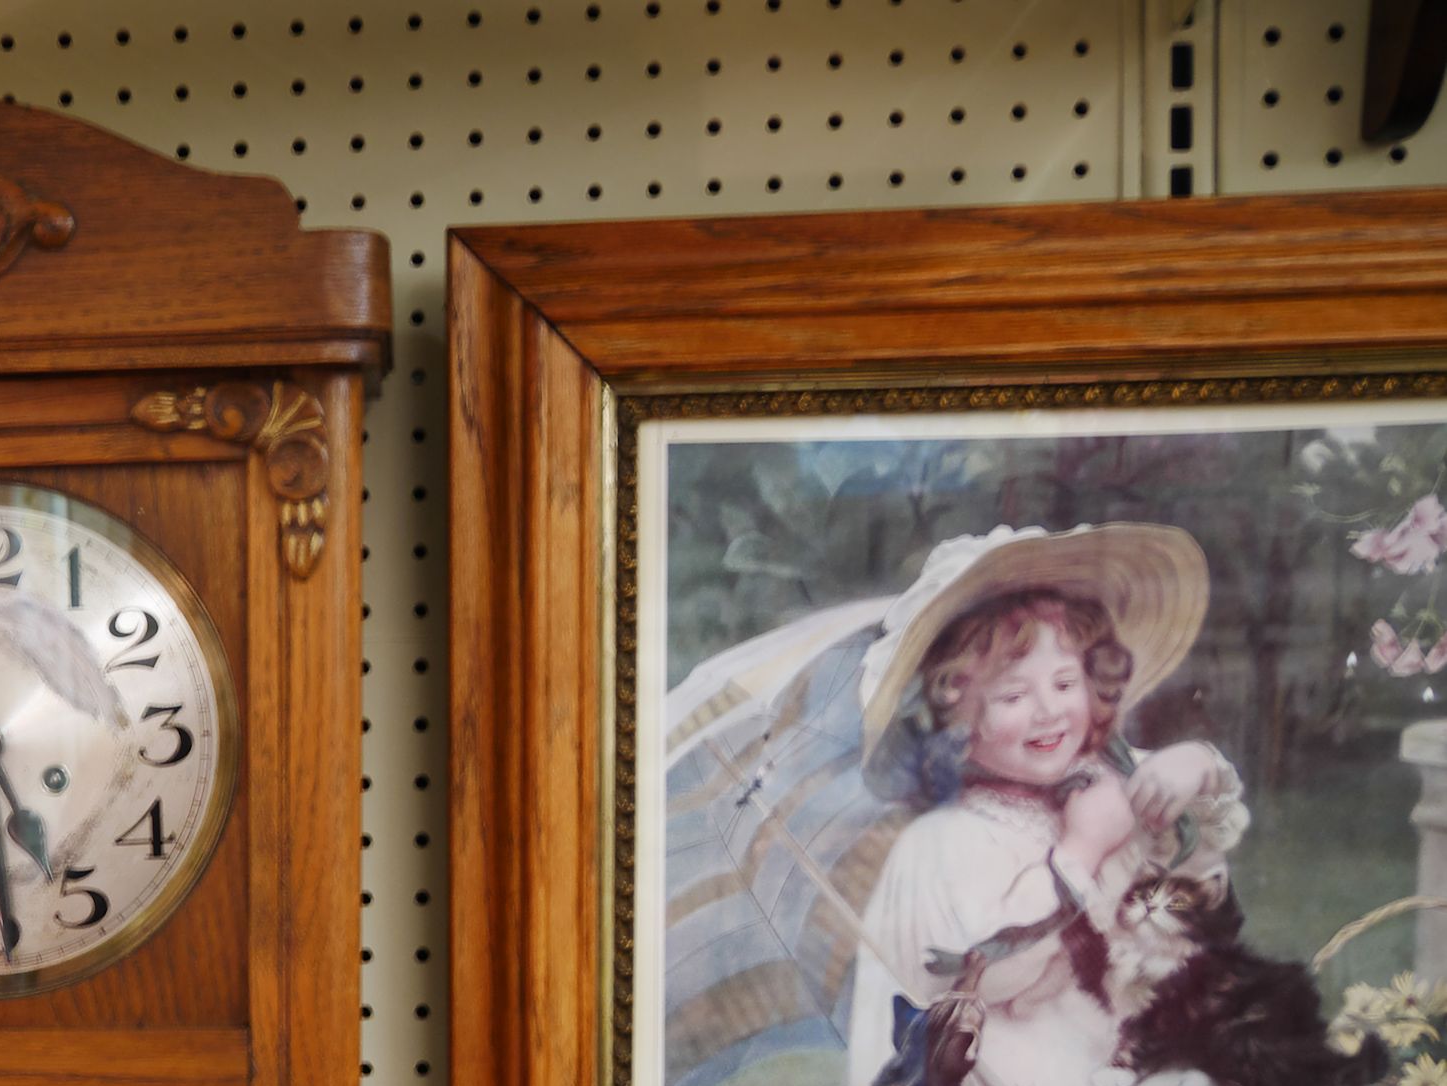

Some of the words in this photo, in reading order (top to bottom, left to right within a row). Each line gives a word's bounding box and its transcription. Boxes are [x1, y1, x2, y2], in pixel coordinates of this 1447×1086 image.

[63, 543, 85, 609] 1
[105, 606, 160, 673] 2
[138, 705, 194, 768] 3
[114, 796, 177, 860] 4
[55, 865, 110, 930] 5
